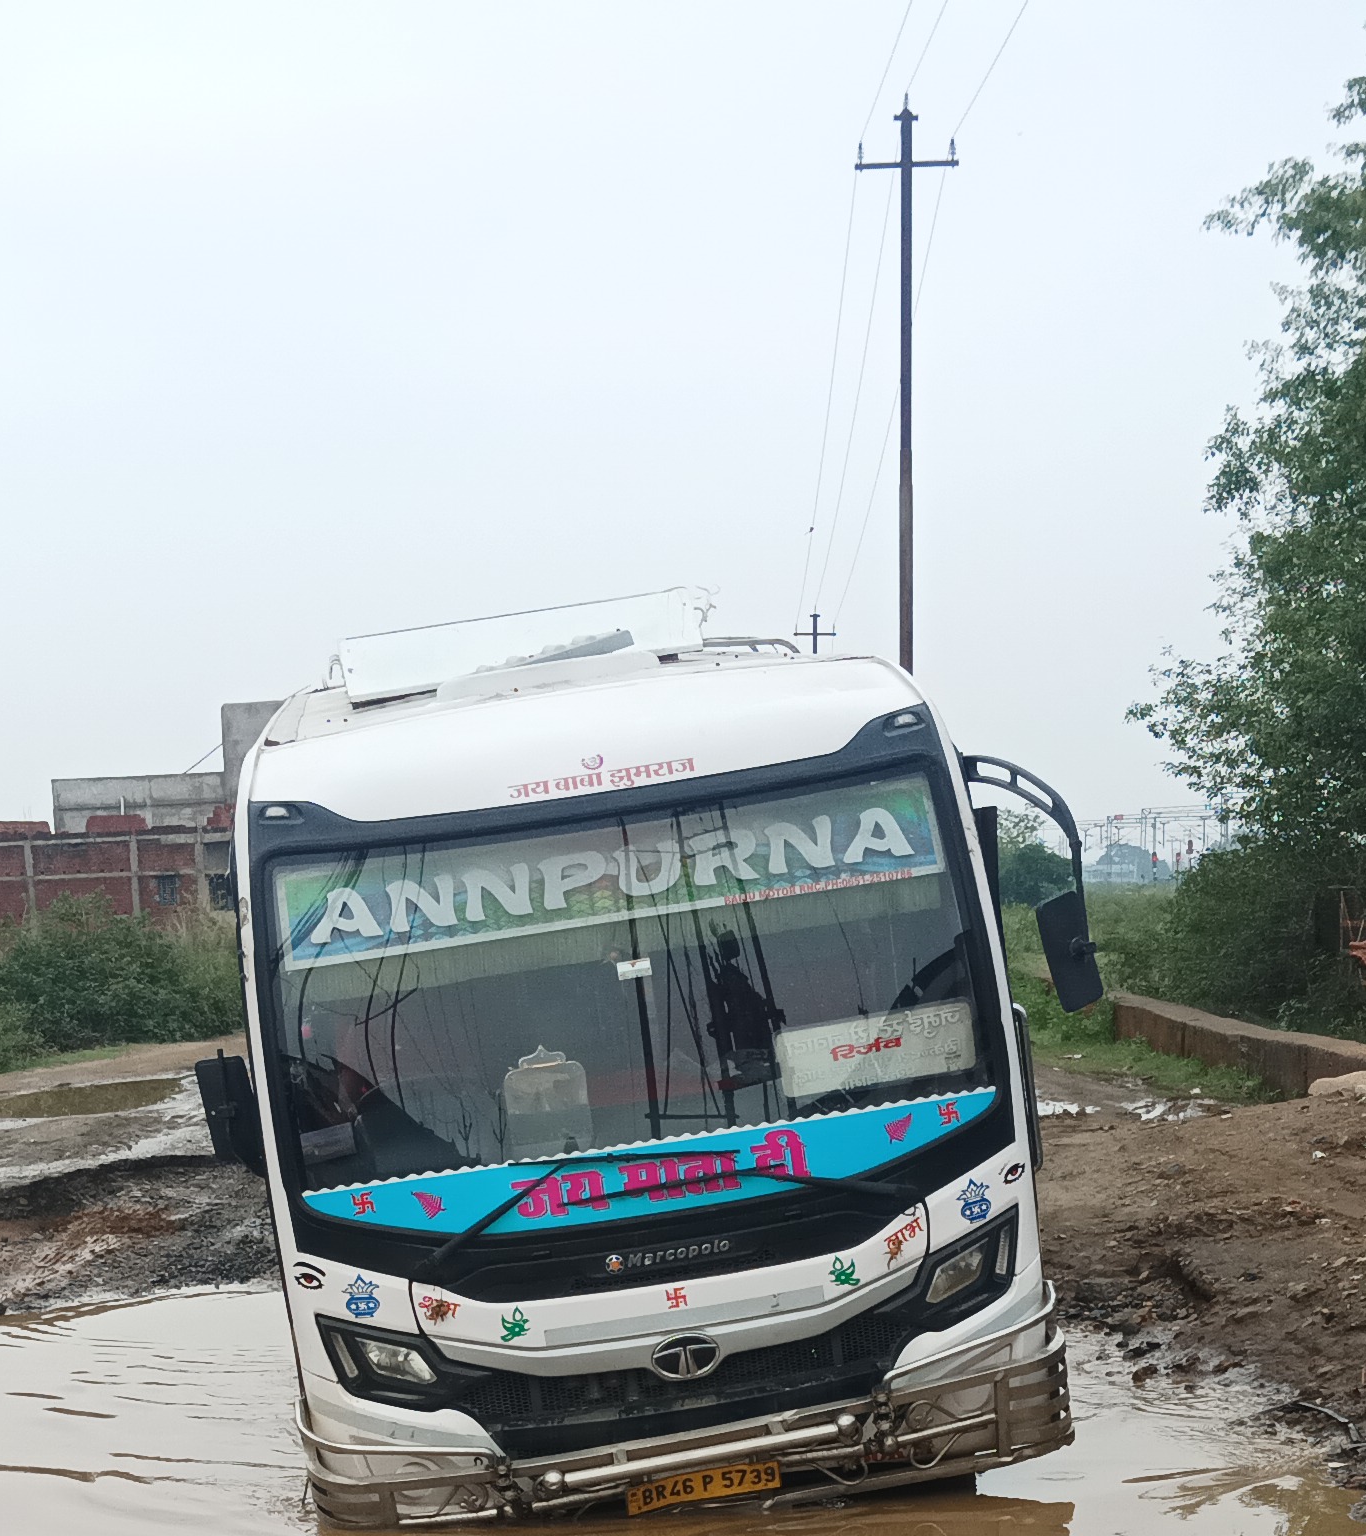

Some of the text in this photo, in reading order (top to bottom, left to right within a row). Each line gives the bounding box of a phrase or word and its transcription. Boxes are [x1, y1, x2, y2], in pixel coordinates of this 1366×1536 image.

[507, 757, 696, 799] जय बाबा झुमराज
[309, 807, 916, 944] ANNPURNA
[759, 885, 797, 900] MOTOR
[511, 1128, 812, 1219] जय माता दी
[627, 1239, 730, 1268] Marcopolo
[641, 1478, 695, 1507] BR46
[701, 1474, 714, 1493] P
[721, 1465, 776, 1489] 5739
